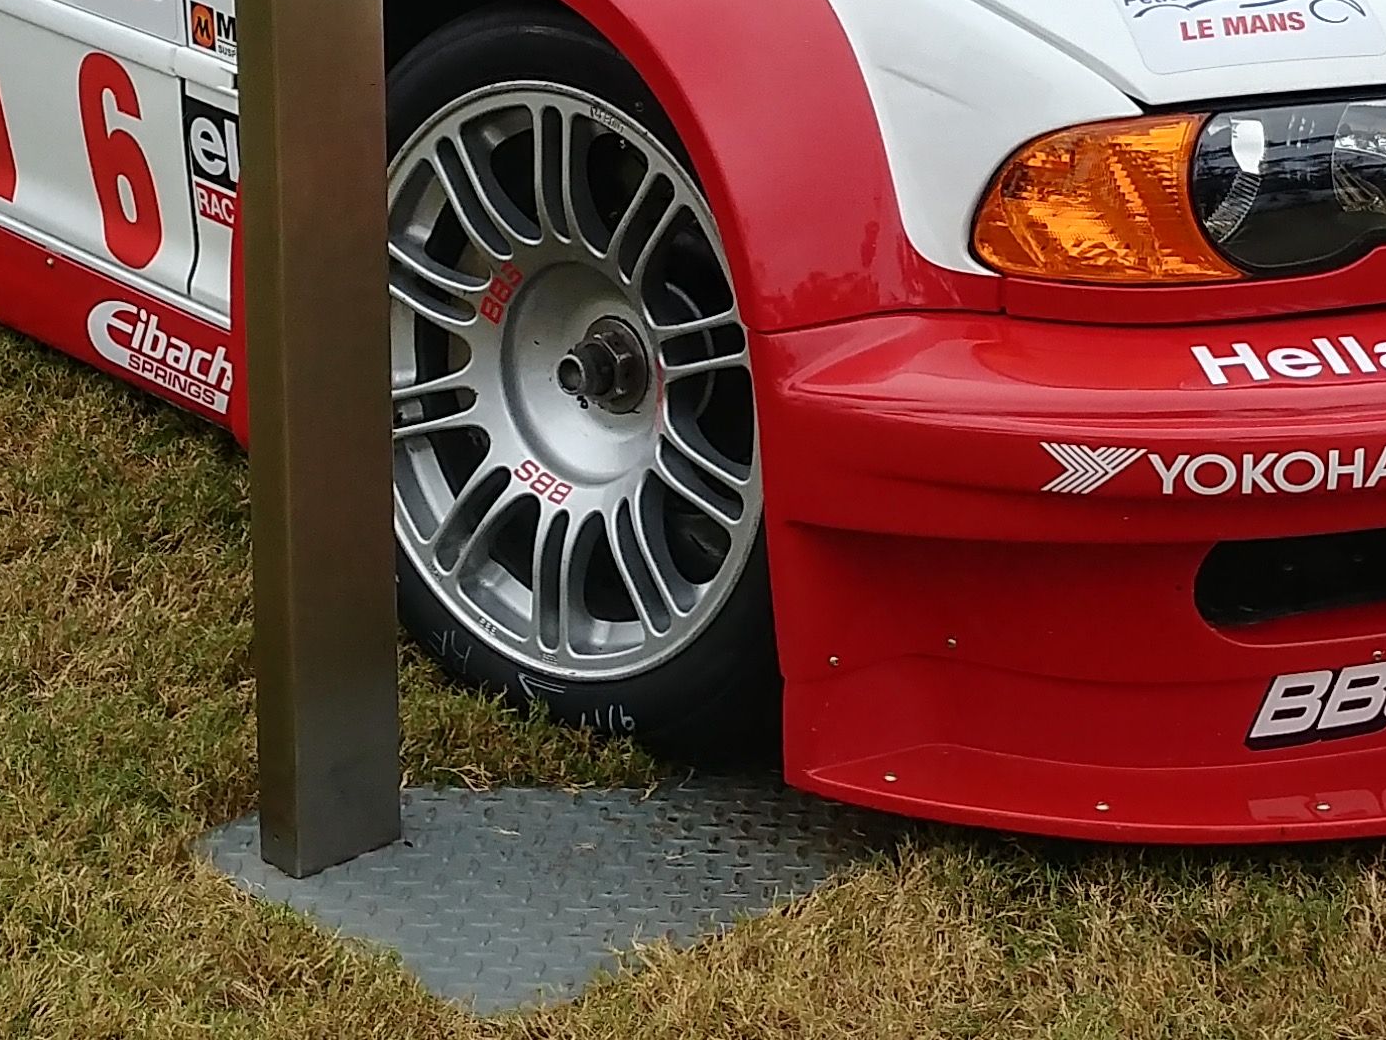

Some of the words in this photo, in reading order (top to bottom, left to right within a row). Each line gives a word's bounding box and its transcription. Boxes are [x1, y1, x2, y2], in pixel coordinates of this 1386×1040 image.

[1180, 19, 1215, 41] LE
[1222, 11, 1306, 36] MANS
[78, 51, 163, 270] 6
[87, 300, 233, 392] Eibach
[128, 353, 217, 406] SPRINGS
